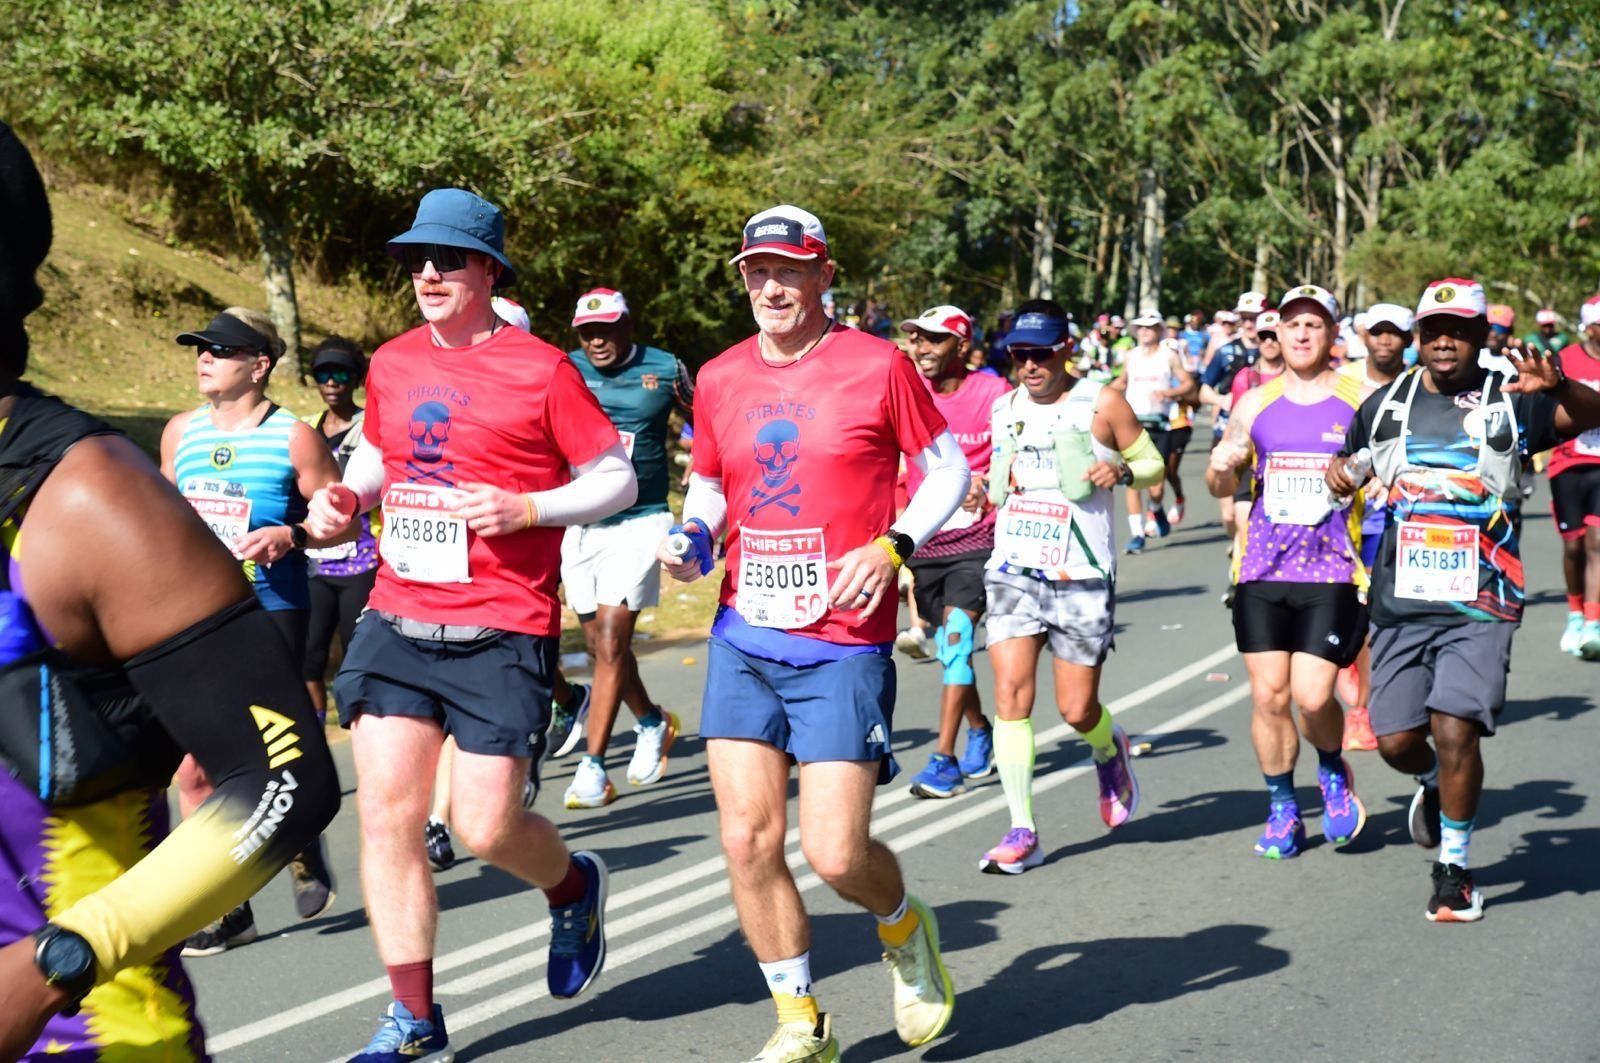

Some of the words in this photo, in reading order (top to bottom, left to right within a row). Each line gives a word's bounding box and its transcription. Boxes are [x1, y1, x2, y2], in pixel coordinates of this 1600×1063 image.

[407, 385, 471, 407] PIRATES
[745, 402, 817, 425] PIRATES
[953, 431, 992, 445] TALIT
[1278, 477, 1323, 494] L11713
[389, 490, 448, 509] THIRS
[390, 516, 458, 544] K58887
[1007, 519, 1061, 541] L25024
[1404, 528, 1470, 543] THTI
[744, 536, 817, 551] THIRSTI
[1040, 546, 1061, 566] 50
[1409, 549, 1466, 570] K51831
[745, 562, 818, 589] E58005
[1450, 575, 1474, 594] 40
[794, 593, 823, 623] 50
